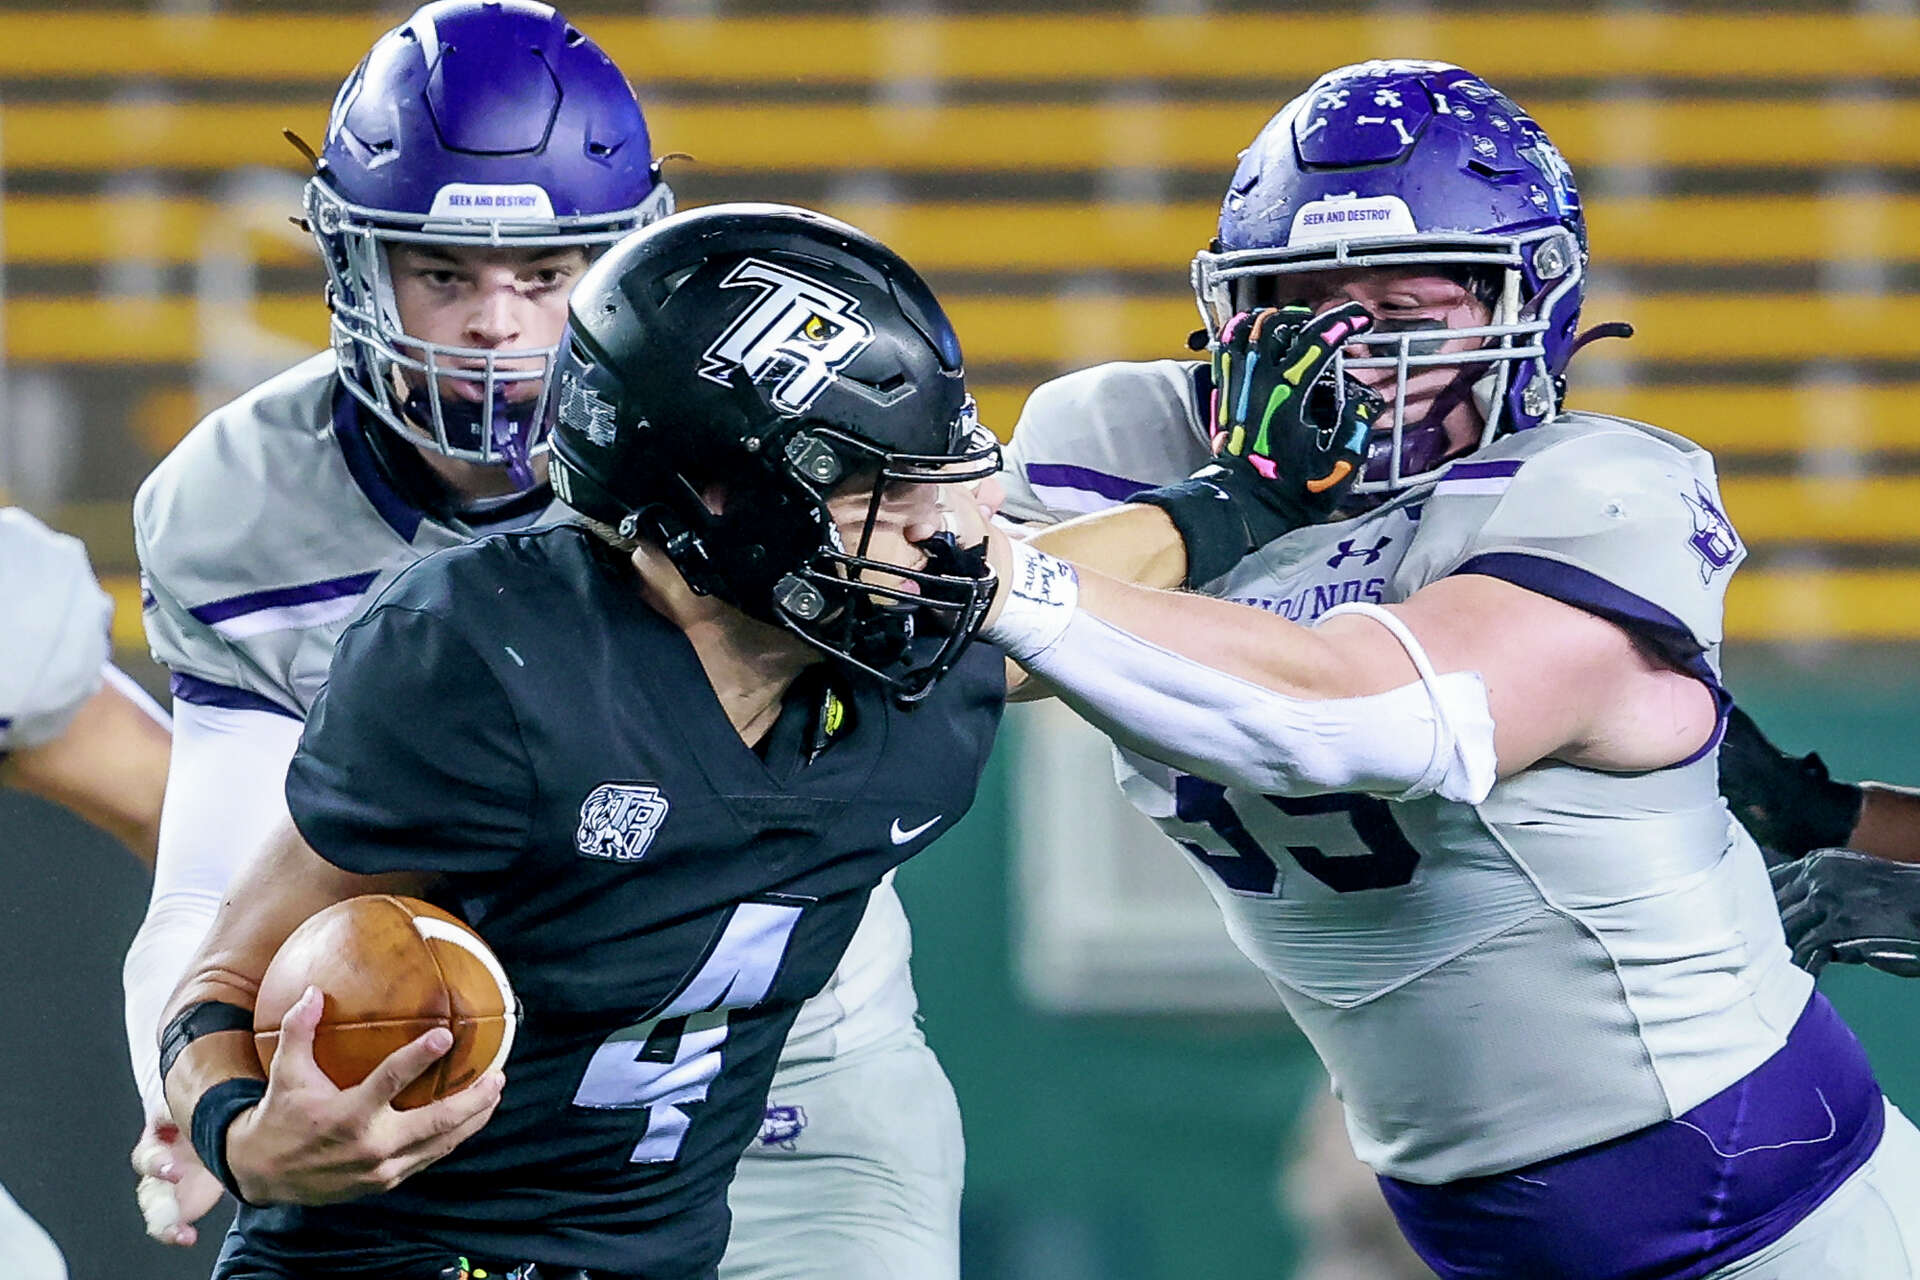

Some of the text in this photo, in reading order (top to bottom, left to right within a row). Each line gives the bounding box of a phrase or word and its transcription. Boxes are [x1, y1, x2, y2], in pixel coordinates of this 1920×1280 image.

[449, 194, 537, 207] SEEK AND DESTROY
[1303, 209, 1391, 225] SEEK AND DESTROY
[572, 902, 804, 1164] 4
